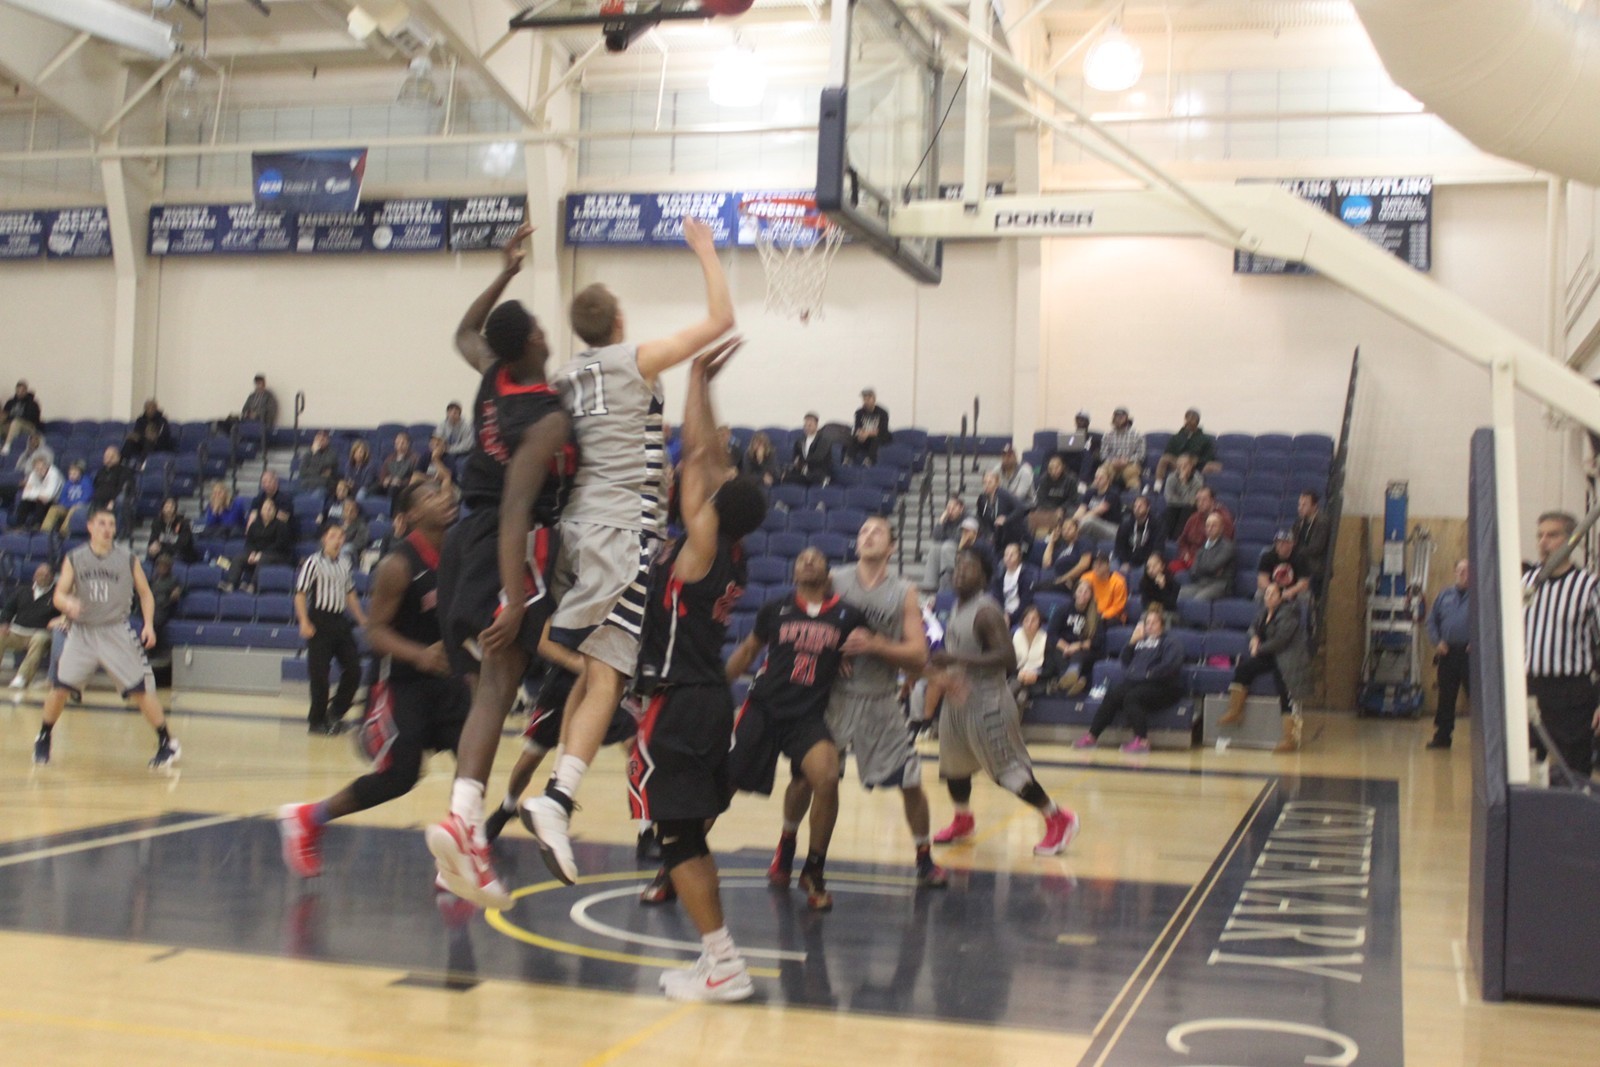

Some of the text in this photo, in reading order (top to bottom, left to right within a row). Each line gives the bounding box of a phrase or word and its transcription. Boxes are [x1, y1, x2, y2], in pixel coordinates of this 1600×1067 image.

[1336, 178, 1432, 195] WRESTLING
[467, 197, 509, 211] MEN'S
[452, 207, 523, 223] LACROSSE
[1342, 206, 1373, 220] NCAA
[568, 361, 608, 417] 11
[1207, 801, 1376, 983] CENTENARY
[1165, 1017, 1359, 1067] C
